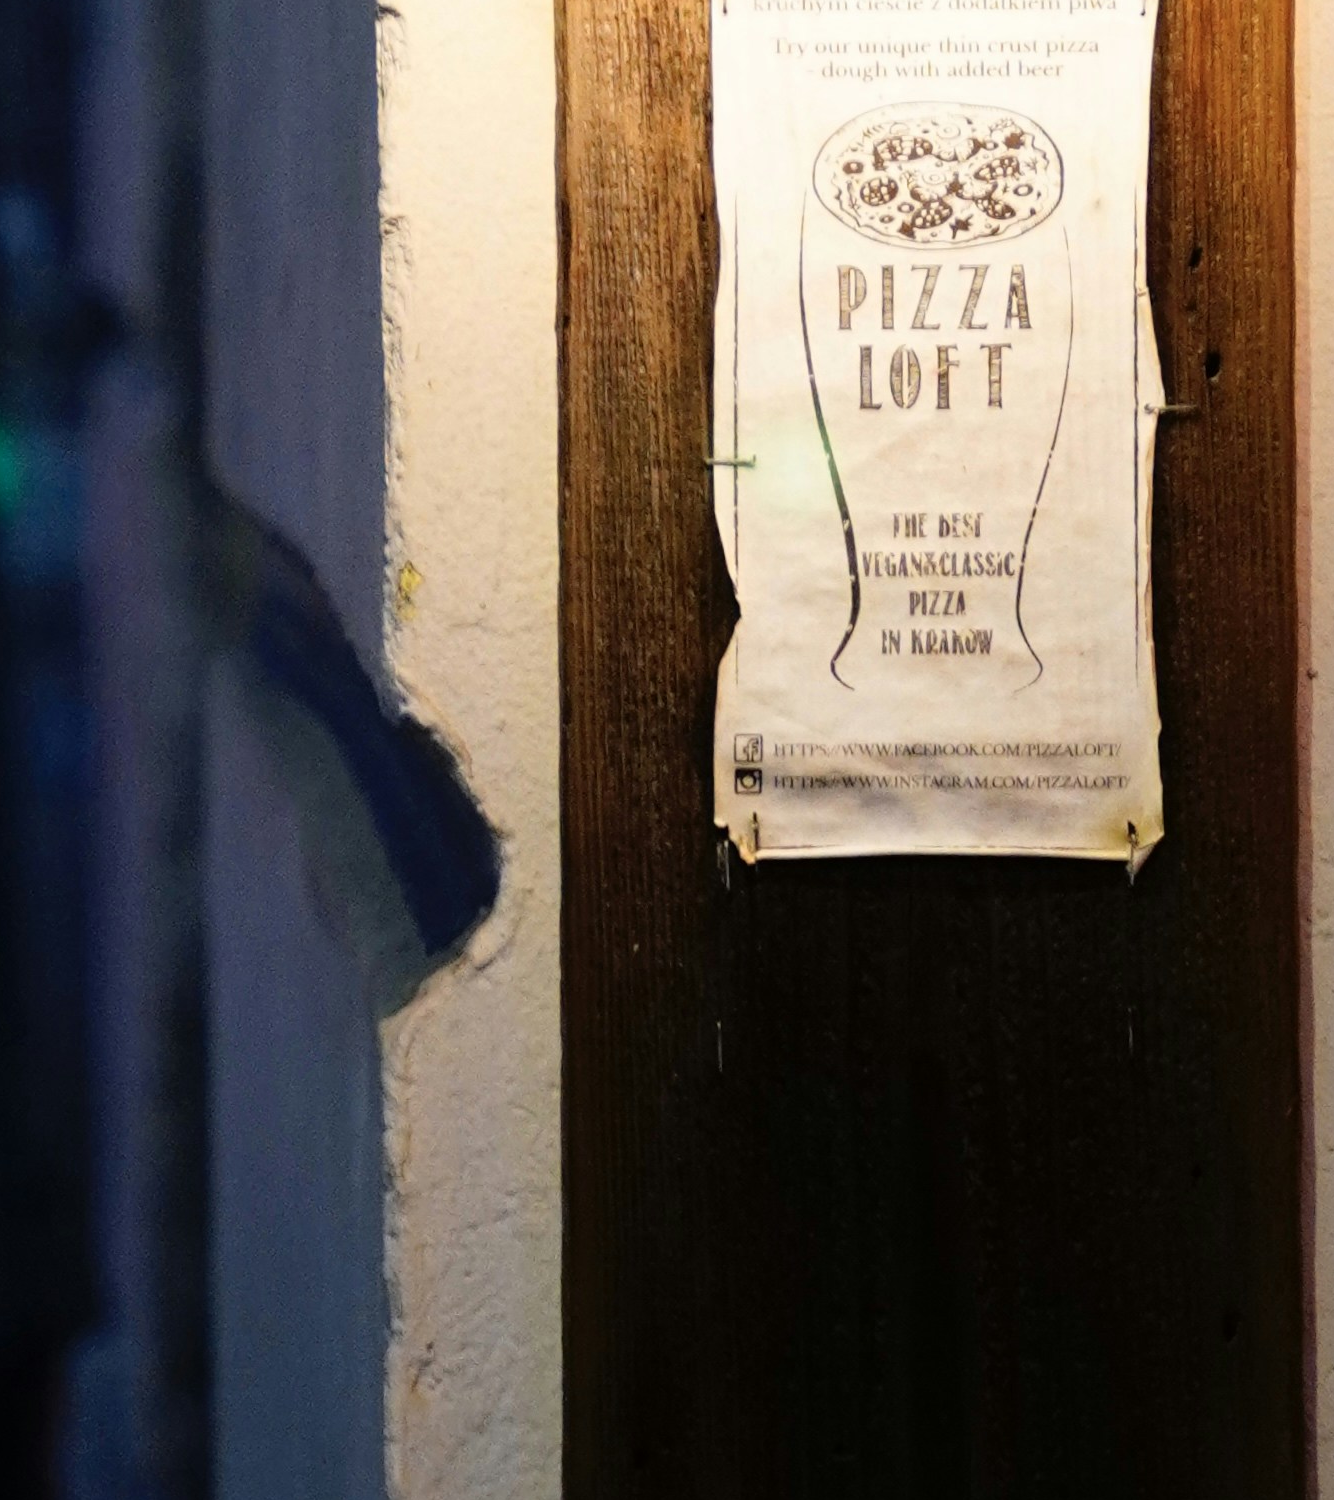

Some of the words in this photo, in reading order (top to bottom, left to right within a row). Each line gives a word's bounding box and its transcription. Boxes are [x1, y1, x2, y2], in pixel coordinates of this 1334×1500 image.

[930, 0, 939, 11] z
[773, 36, 807, 57] Try
[814, 40, 850, 54] our
[857, 38, 931, 57] unique
[938, 35, 980, 53] thin
[987, 37, 1039, 53] crust
[1045, 36, 1099, 57] pizza
[821, 60, 887, 82] dough
[895, 60, 939, 77] with
[947, 60, 1010, 77] added
[1018, 59, 1065, 77] beer
[837, 264, 1032, 330] PIZZA
[859, 343, 1013, 410] LOFT
[892, 512, 928, 538] THE
[938, 512, 984, 538] BEST
[862, 550, 1016, 578] VEGAN&CLASSIC
[908, 590, 967, 616] PIZZA
[881, 628, 901, 656] IN
